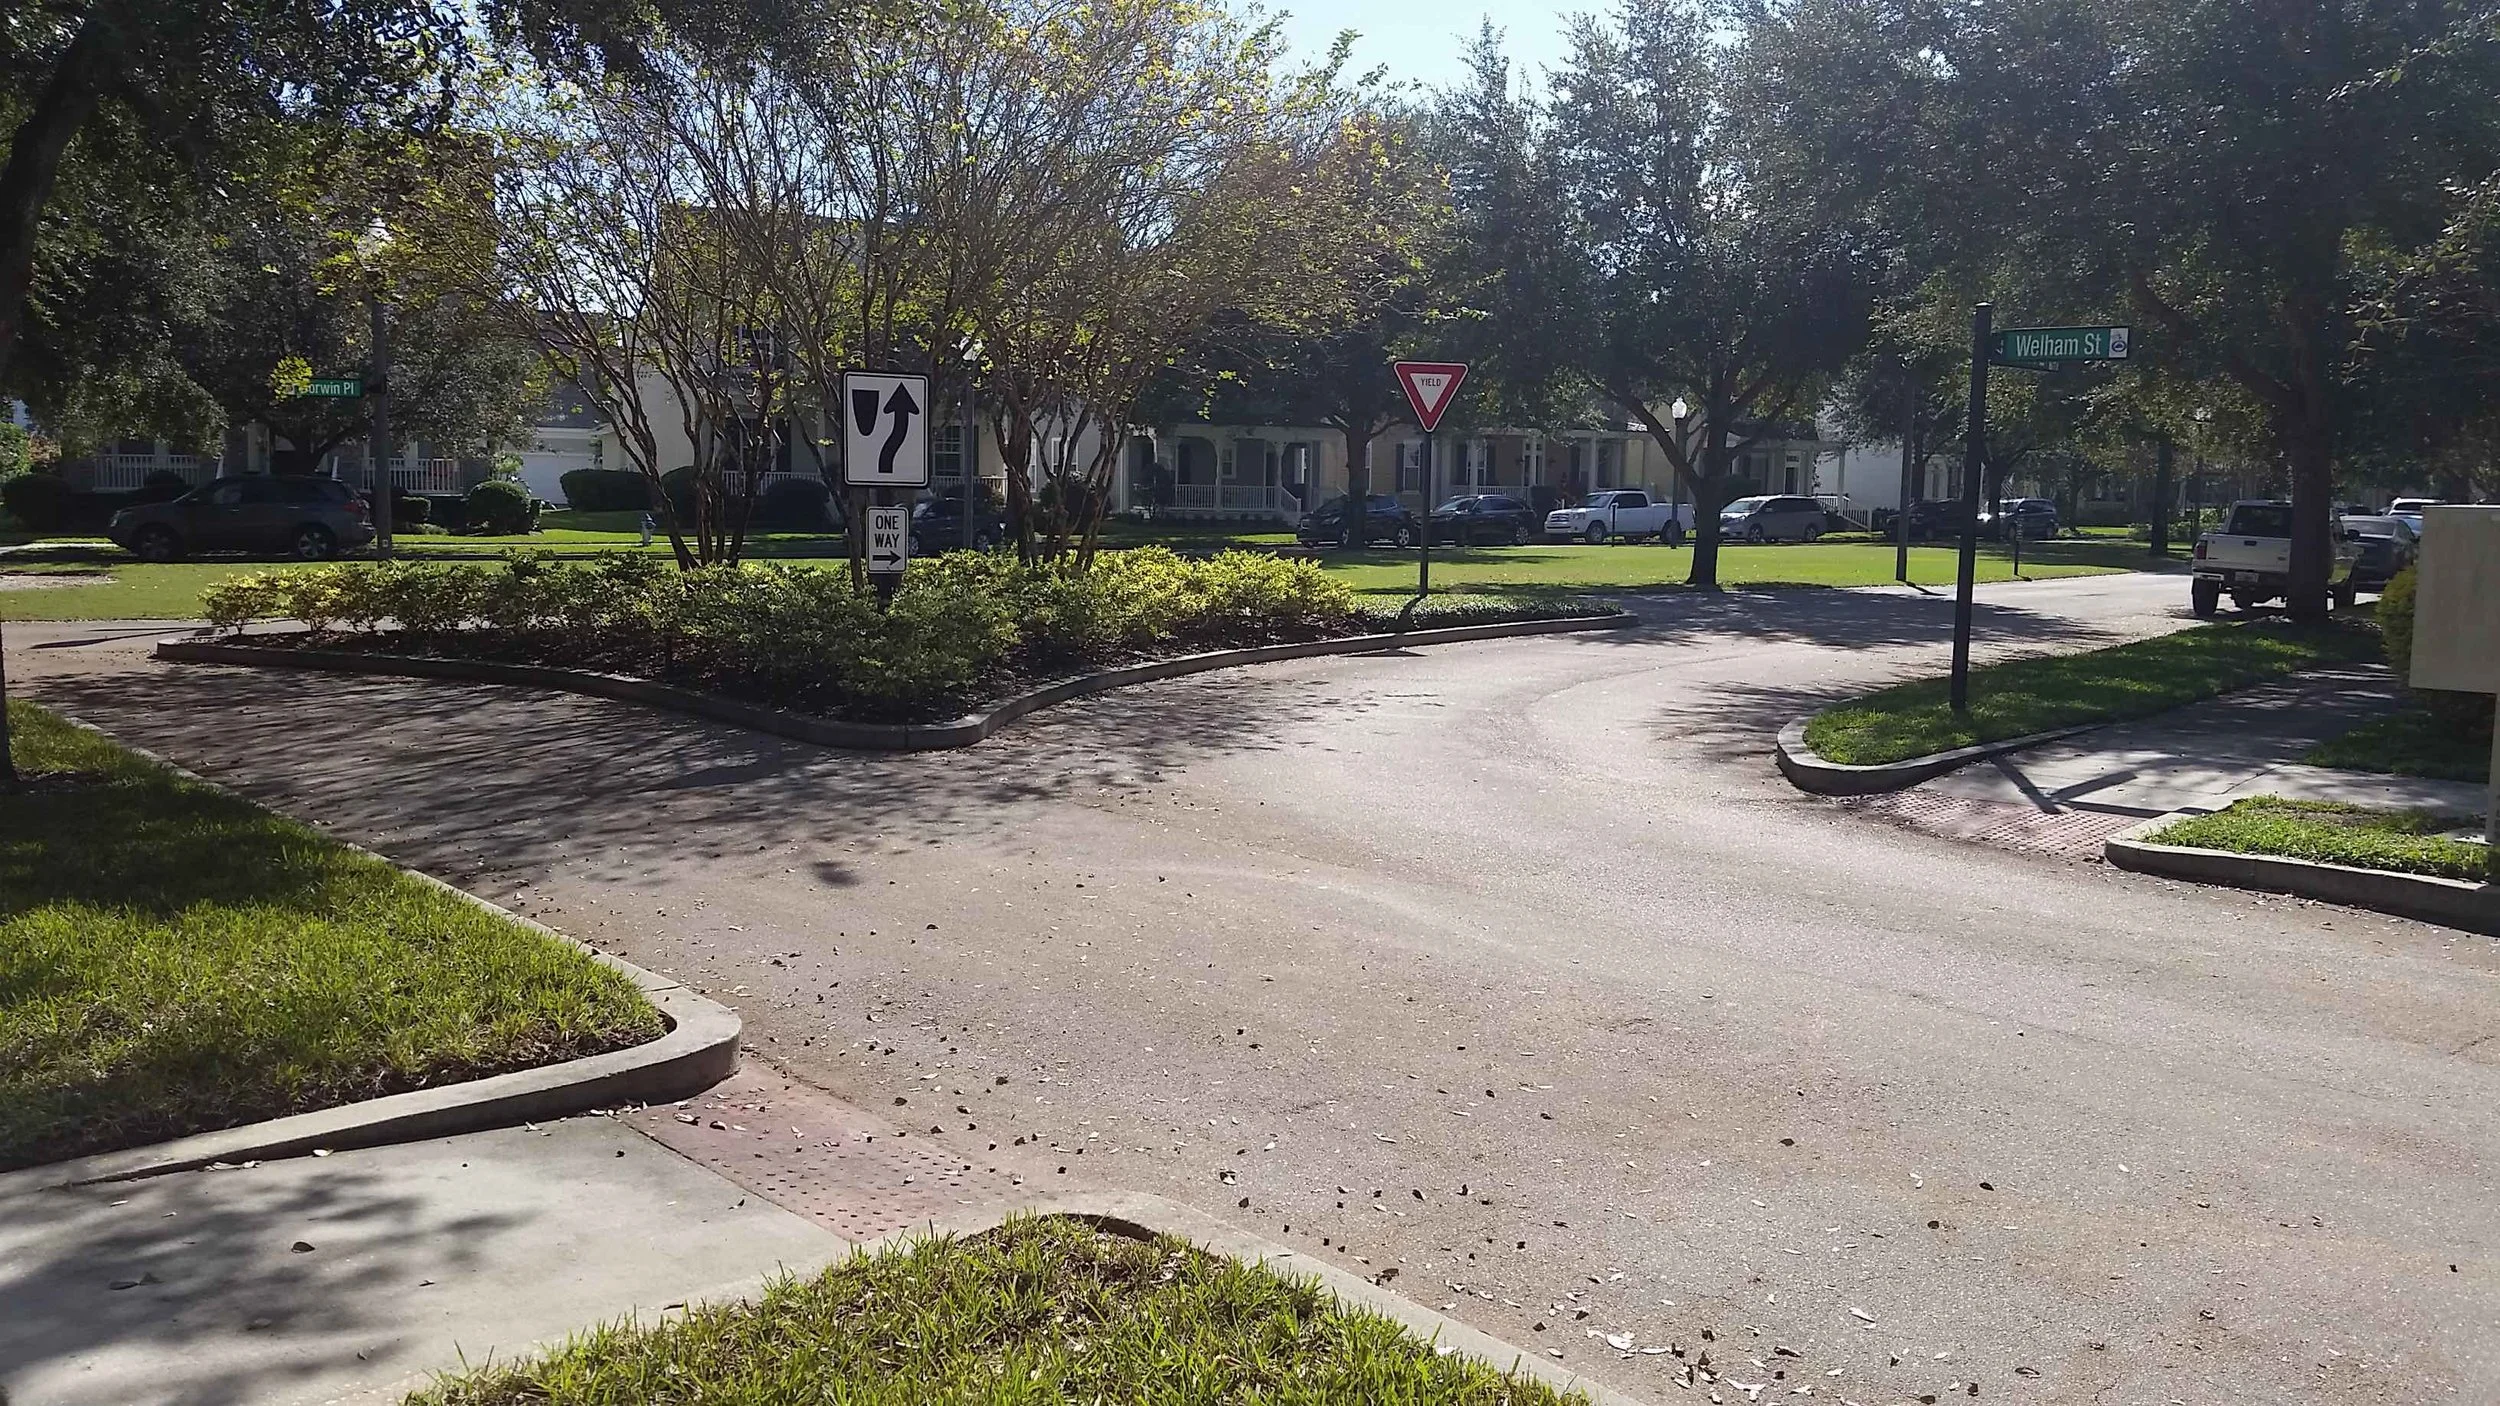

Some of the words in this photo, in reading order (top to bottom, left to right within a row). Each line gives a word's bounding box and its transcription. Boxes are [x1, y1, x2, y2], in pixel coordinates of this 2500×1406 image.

[2016, 334, 2078, 357] Welham
[2083, 333, 2102, 355] St
[343, 382, 354, 395] Pl
[1420, 377, 1441, 387] YIELD
[875, 515, 899, 530] ONE
[874, 533, 900, 548] WAY
